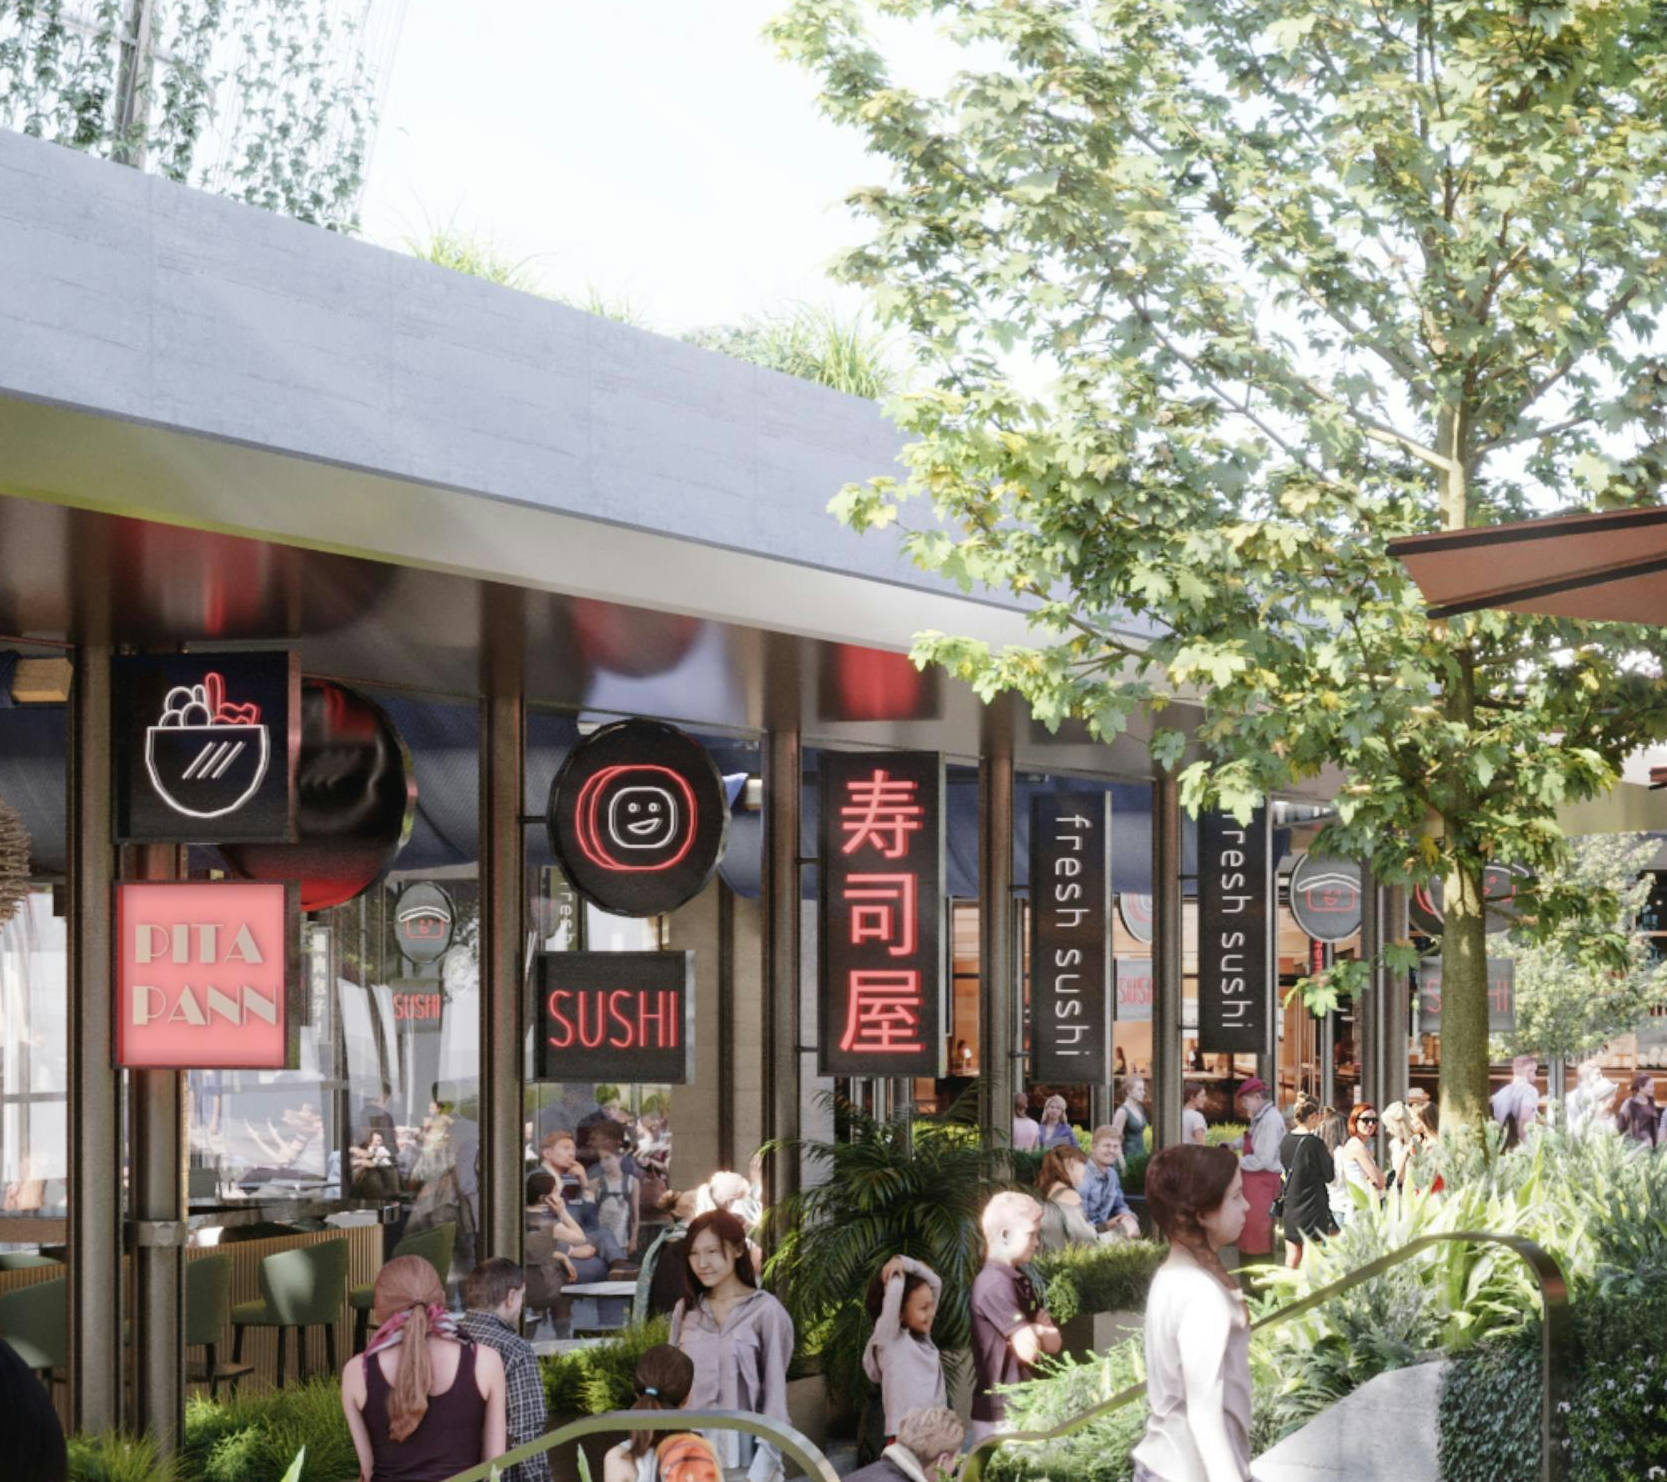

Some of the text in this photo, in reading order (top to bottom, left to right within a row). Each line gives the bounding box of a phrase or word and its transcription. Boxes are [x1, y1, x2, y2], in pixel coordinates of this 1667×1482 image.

[840, 770, 926, 1053] 寿司屋
[1054, 814, 1092, 1056] fresh sushi
[135, 923, 263, 964] PITA
[132, 984, 277, 1026] PANN
[1221, 932, 1254, 1028] sushi
[1425, 979, 1509, 1015] SHI
[393, 993, 441, 1020] SUSHI
[548, 989, 678, 1048] SUSHI
